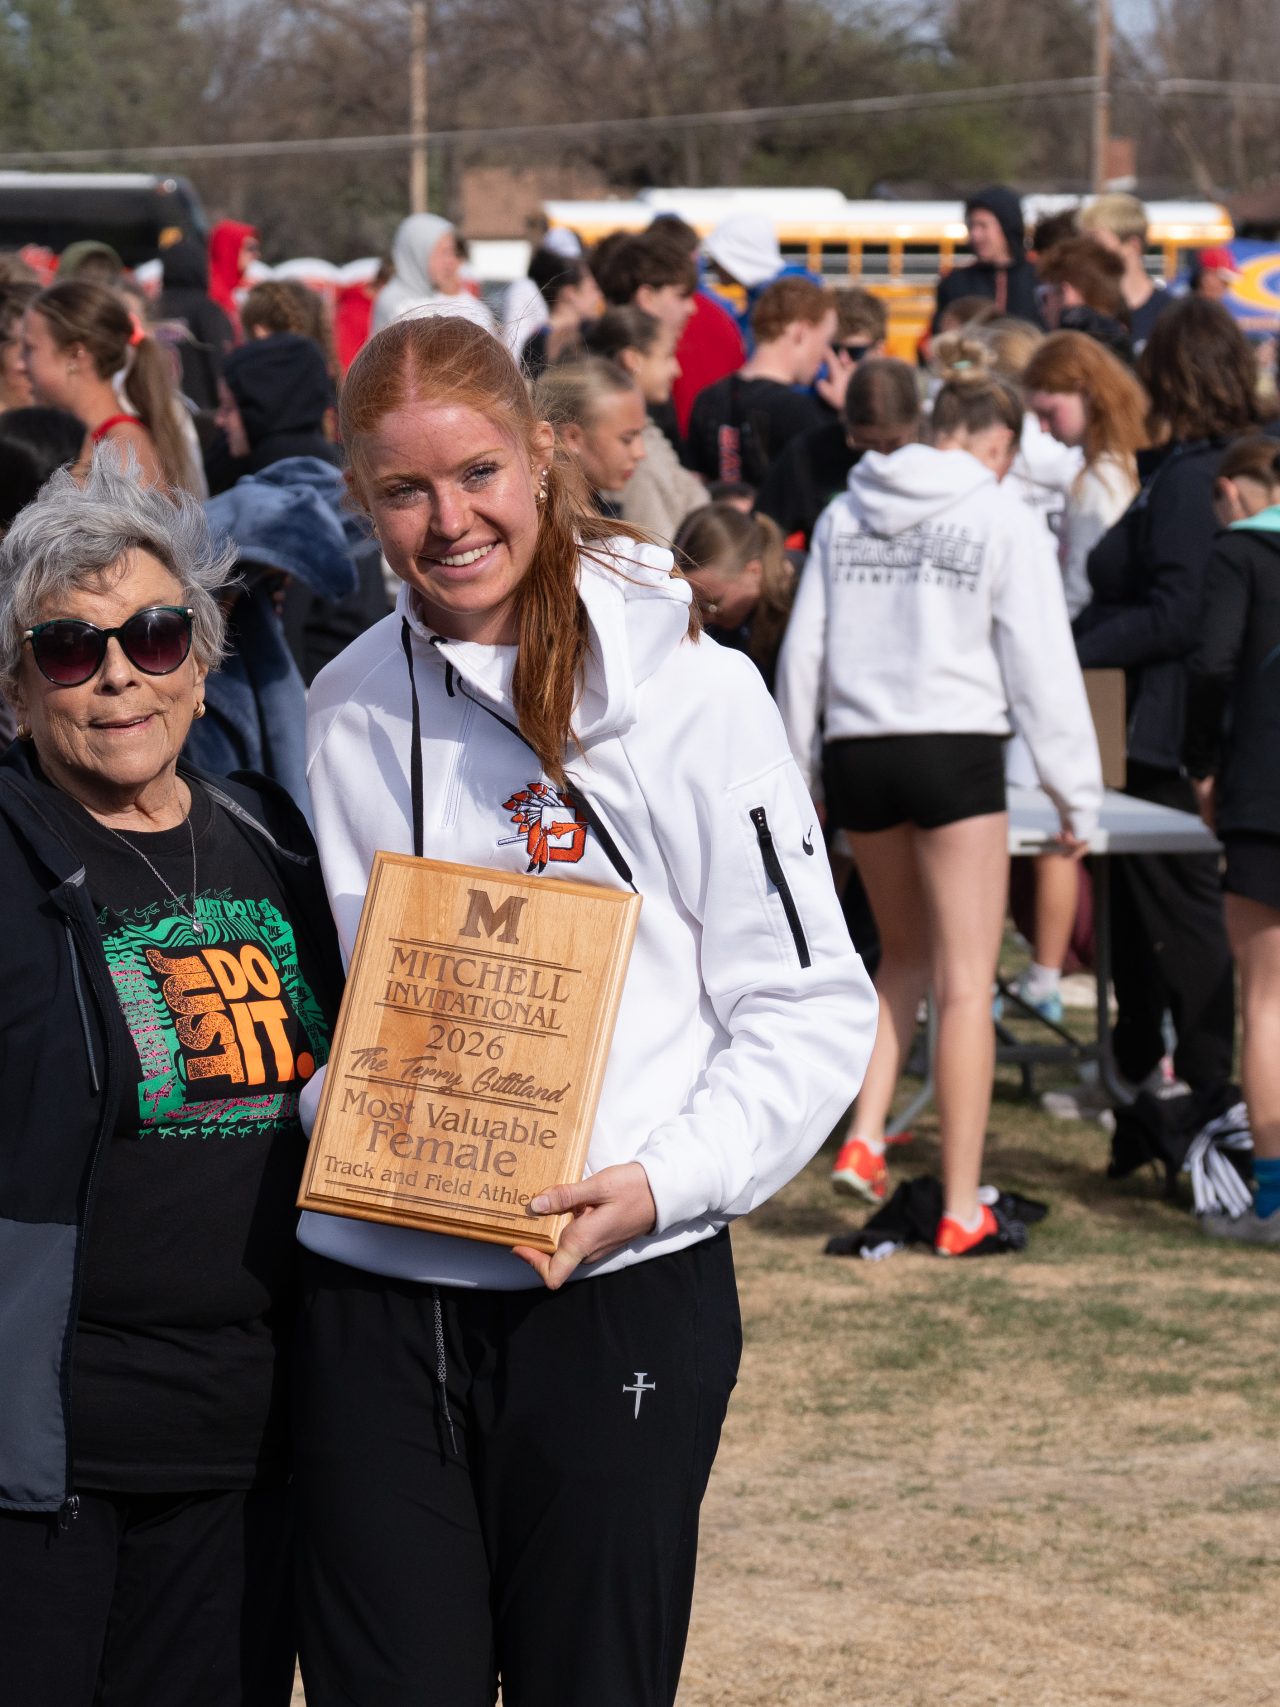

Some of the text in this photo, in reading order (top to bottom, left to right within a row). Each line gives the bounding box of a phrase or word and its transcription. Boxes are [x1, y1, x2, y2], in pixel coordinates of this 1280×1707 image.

[195, 897, 223, 918] JUST
[224, 900, 247, 918] DO
[459, 888, 528, 944] M
[387, 946, 570, 1003] MITCHELL
[145, 949, 246, 1084] JUST
[201, 944, 281, 1000] DO
[383, 980, 563, 1030] INVITATIONAL
[425, 1024, 506, 1060] 2026
[351, 1047, 388, 1072] The
[400, 1055, 463, 1094] Terry
[340, 1088, 558, 1149] Most Valuable
[365, 1120, 518, 1177] Female
[324, 1156, 536, 1208] Track and Field Athlet
